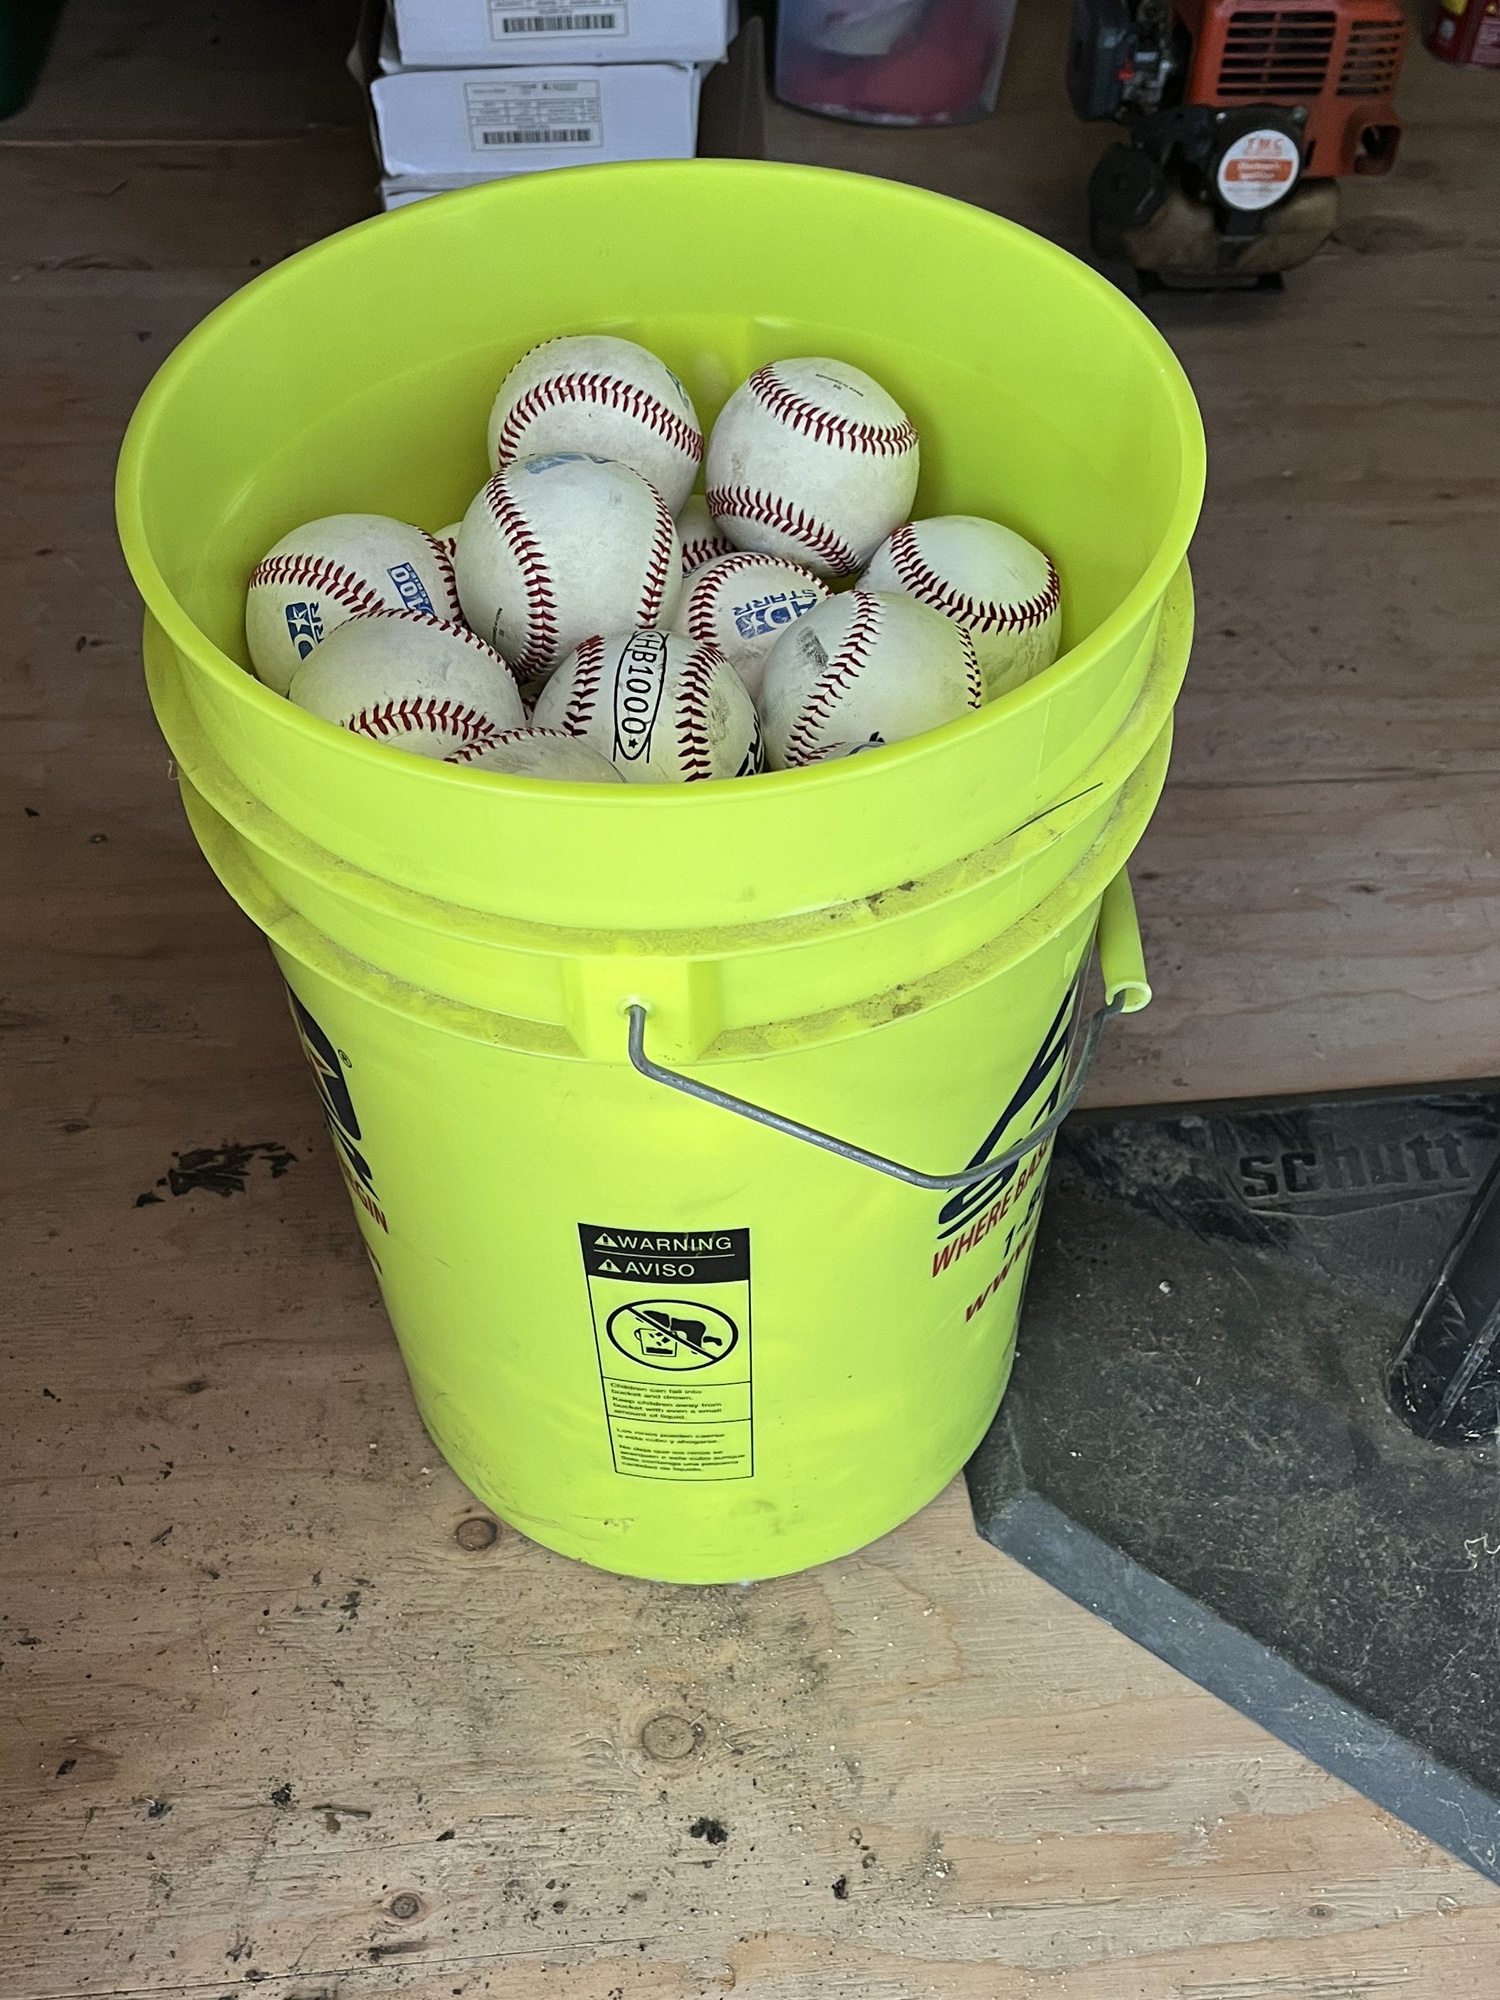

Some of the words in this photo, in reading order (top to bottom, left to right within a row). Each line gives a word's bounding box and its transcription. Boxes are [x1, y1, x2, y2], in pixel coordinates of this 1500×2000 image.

[620, 637, 661, 735] HB1000
[932, 1184, 1015, 1278] WHERE
[616, 1235, 732, 1252] WARNING
[625, 1261, 695, 1277] AVISO
[611, 1383, 647, 1392] Children
